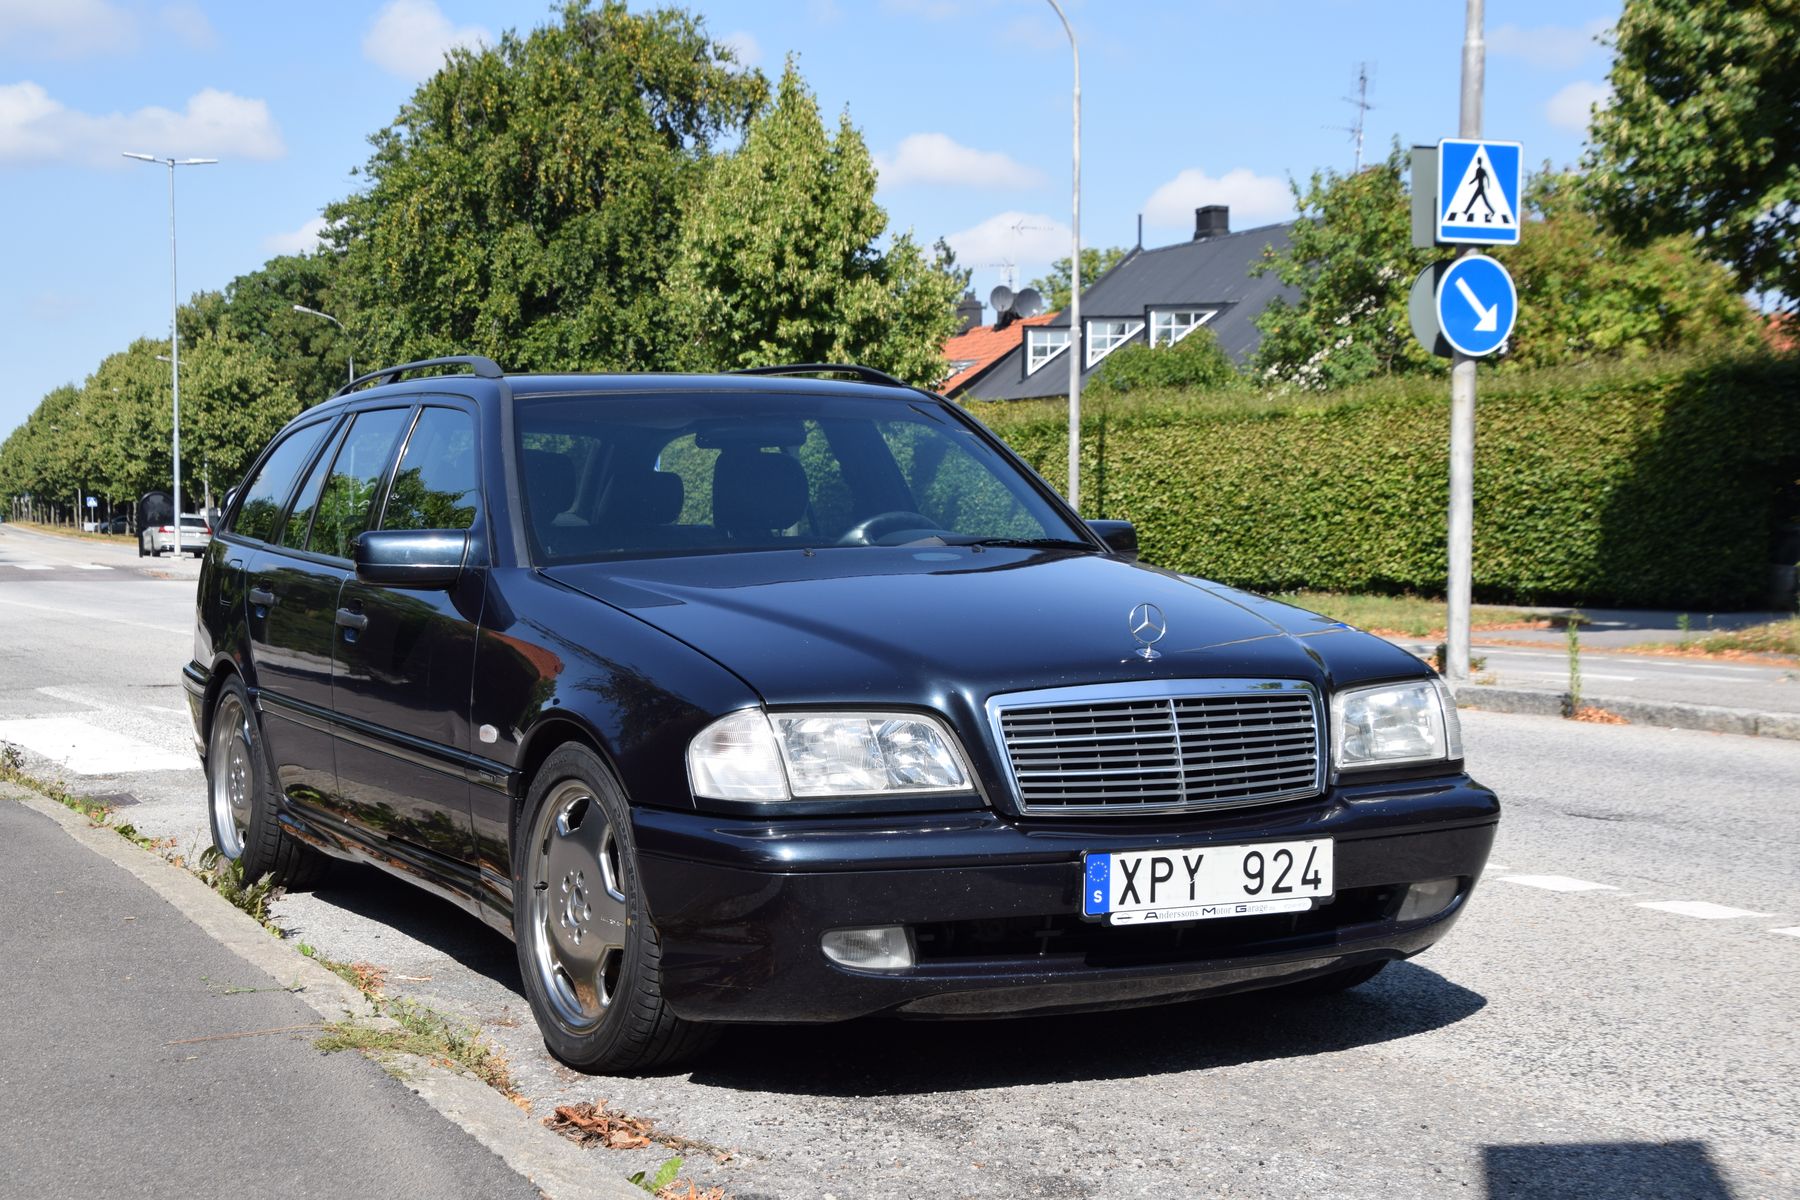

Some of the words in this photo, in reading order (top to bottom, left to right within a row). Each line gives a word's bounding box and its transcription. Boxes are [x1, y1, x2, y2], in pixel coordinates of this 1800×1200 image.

[1118, 854, 1204, 906] XPY
[1242, 846, 1322, 896] 924
[1093, 890, 1103, 903] S
[1144, 908, 1199, 921] Anderssons
[1202, 906, 1231, 917] Motor
[1235, 904, 1268, 914] Garage
